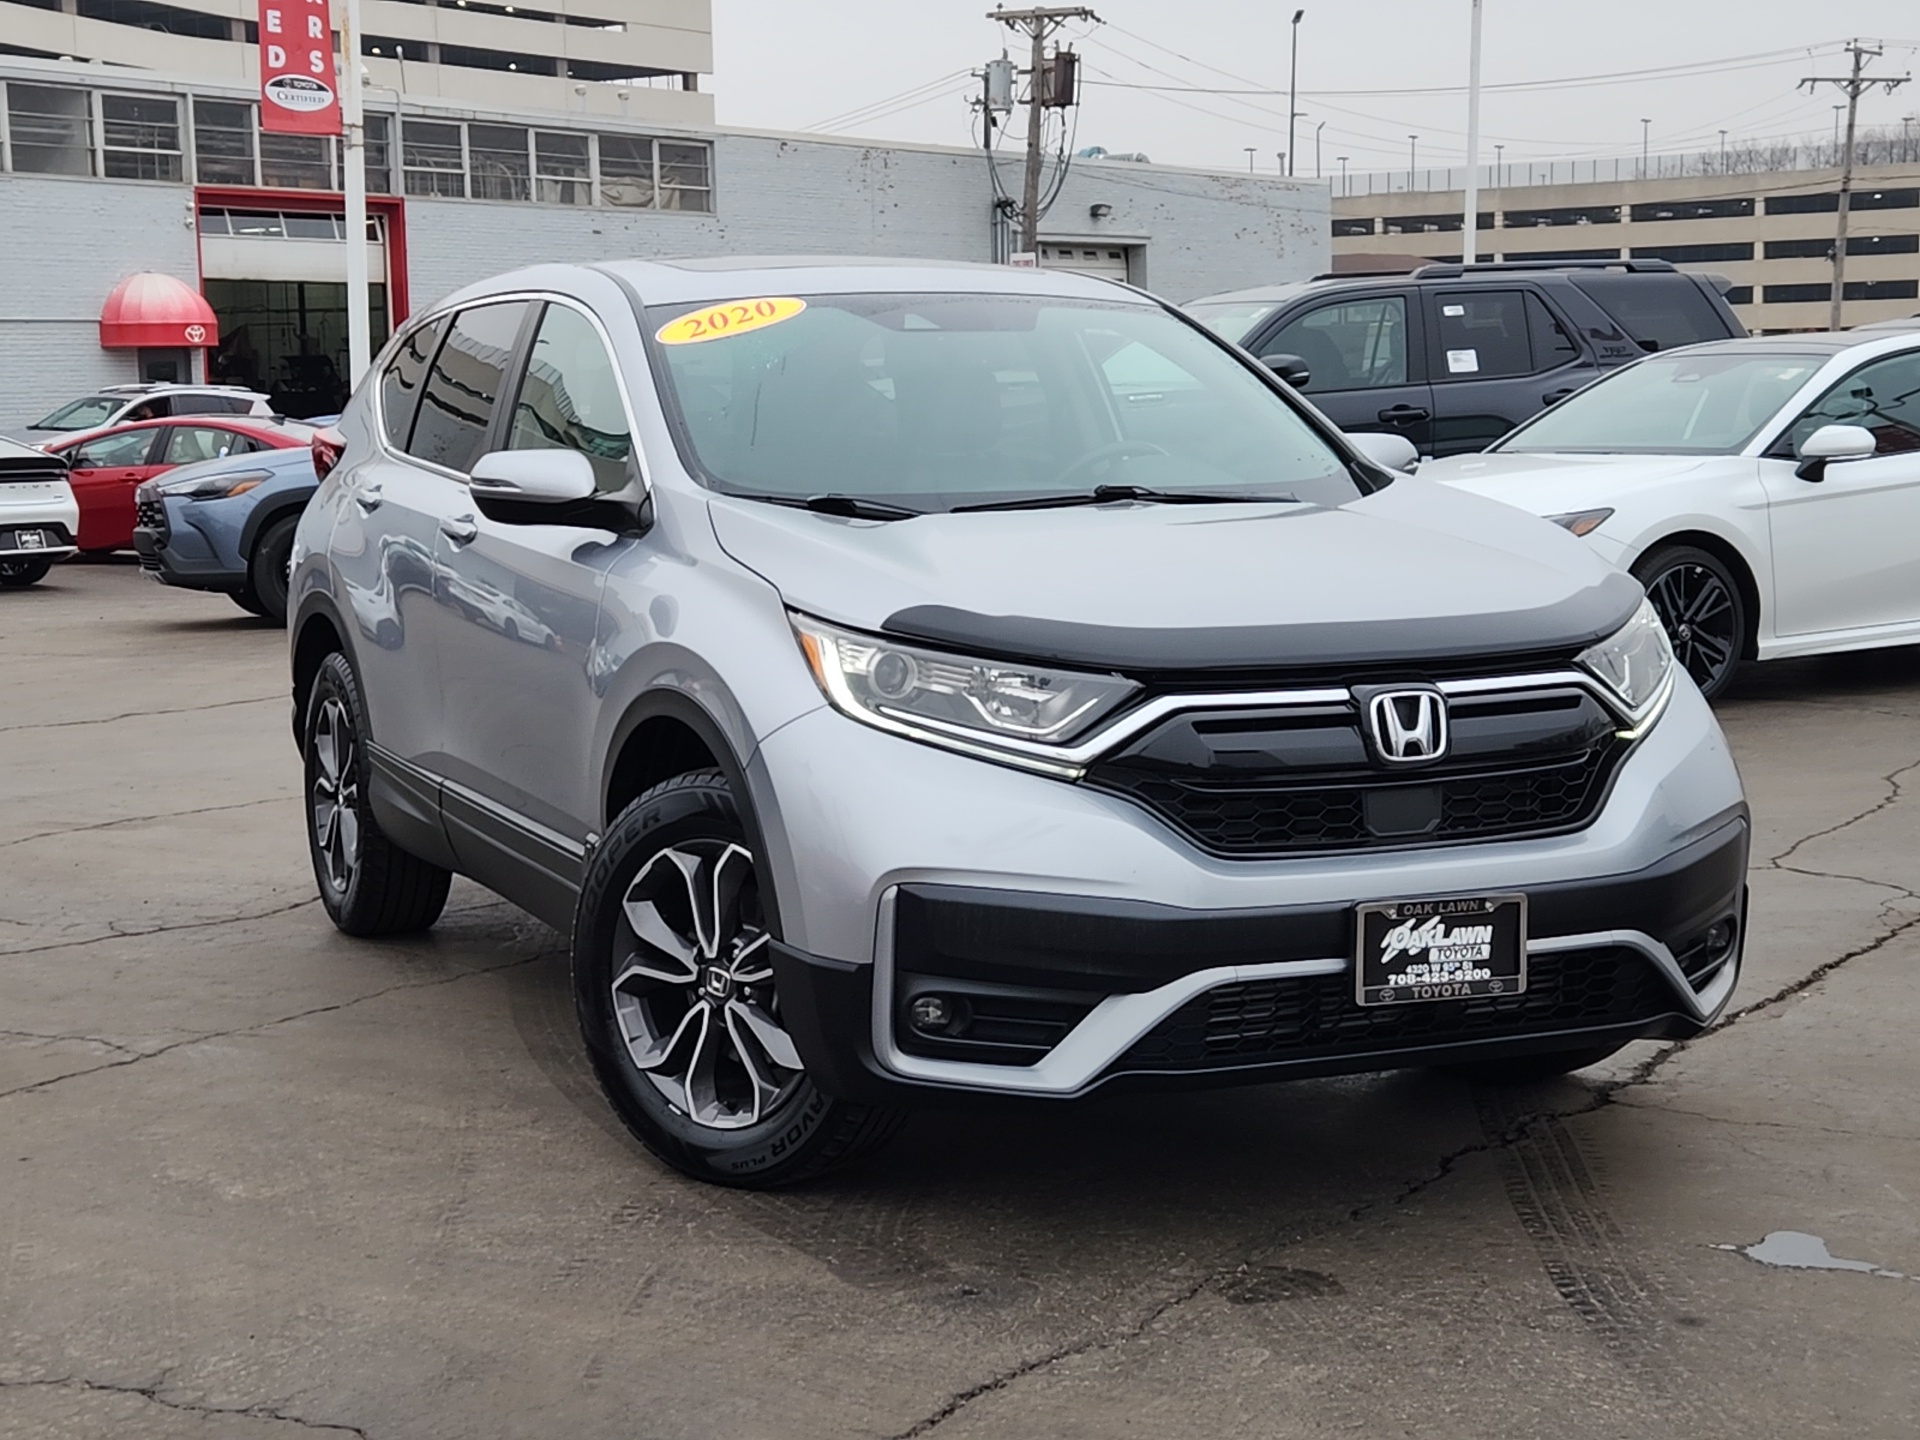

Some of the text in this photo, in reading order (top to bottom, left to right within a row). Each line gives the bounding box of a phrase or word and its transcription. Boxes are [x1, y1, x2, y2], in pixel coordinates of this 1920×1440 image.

[306, 0, 325, 73] RS
[292, 80, 318, 89] TOYOTA
[684, 301, 776, 338] 2020
[1403, 900, 1480, 916] OAK LAWN
[1437, 946, 1483, 960] TOYOTA
[1431, 962, 1441, 973] W
[1387, 968, 1491, 986] 708-423-5200
[1412, 983, 1471, 999] TOYOTA
[731, 1155, 767, 1169] PLUS
